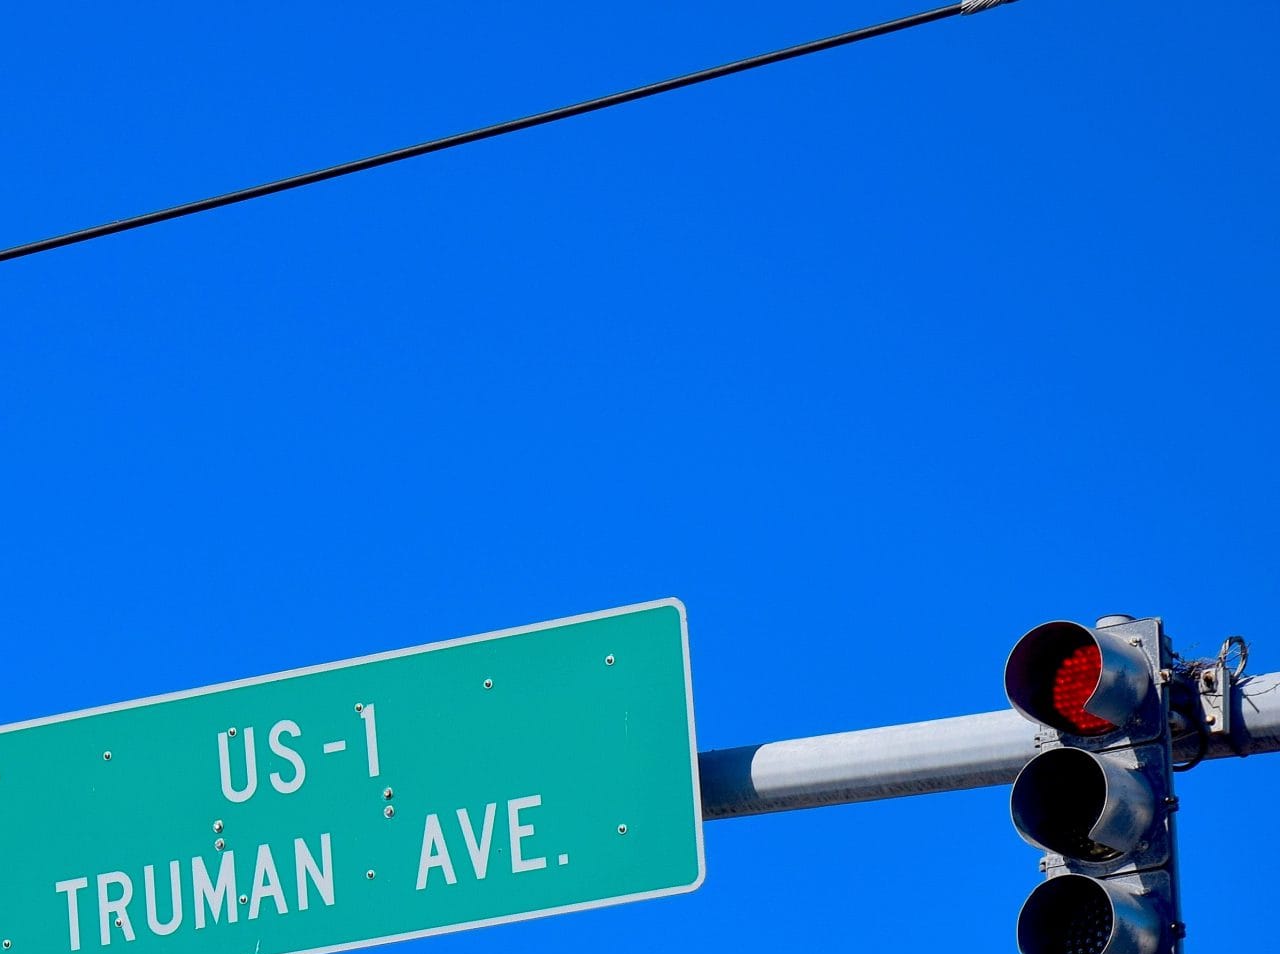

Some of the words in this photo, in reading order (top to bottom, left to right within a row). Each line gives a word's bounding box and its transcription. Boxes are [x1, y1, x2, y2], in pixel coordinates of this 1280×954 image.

[218, 703, 380, 803] US-1
[56, 833, 335, 951] TRUMAN
[416, 794, 569, 890] AVE.
